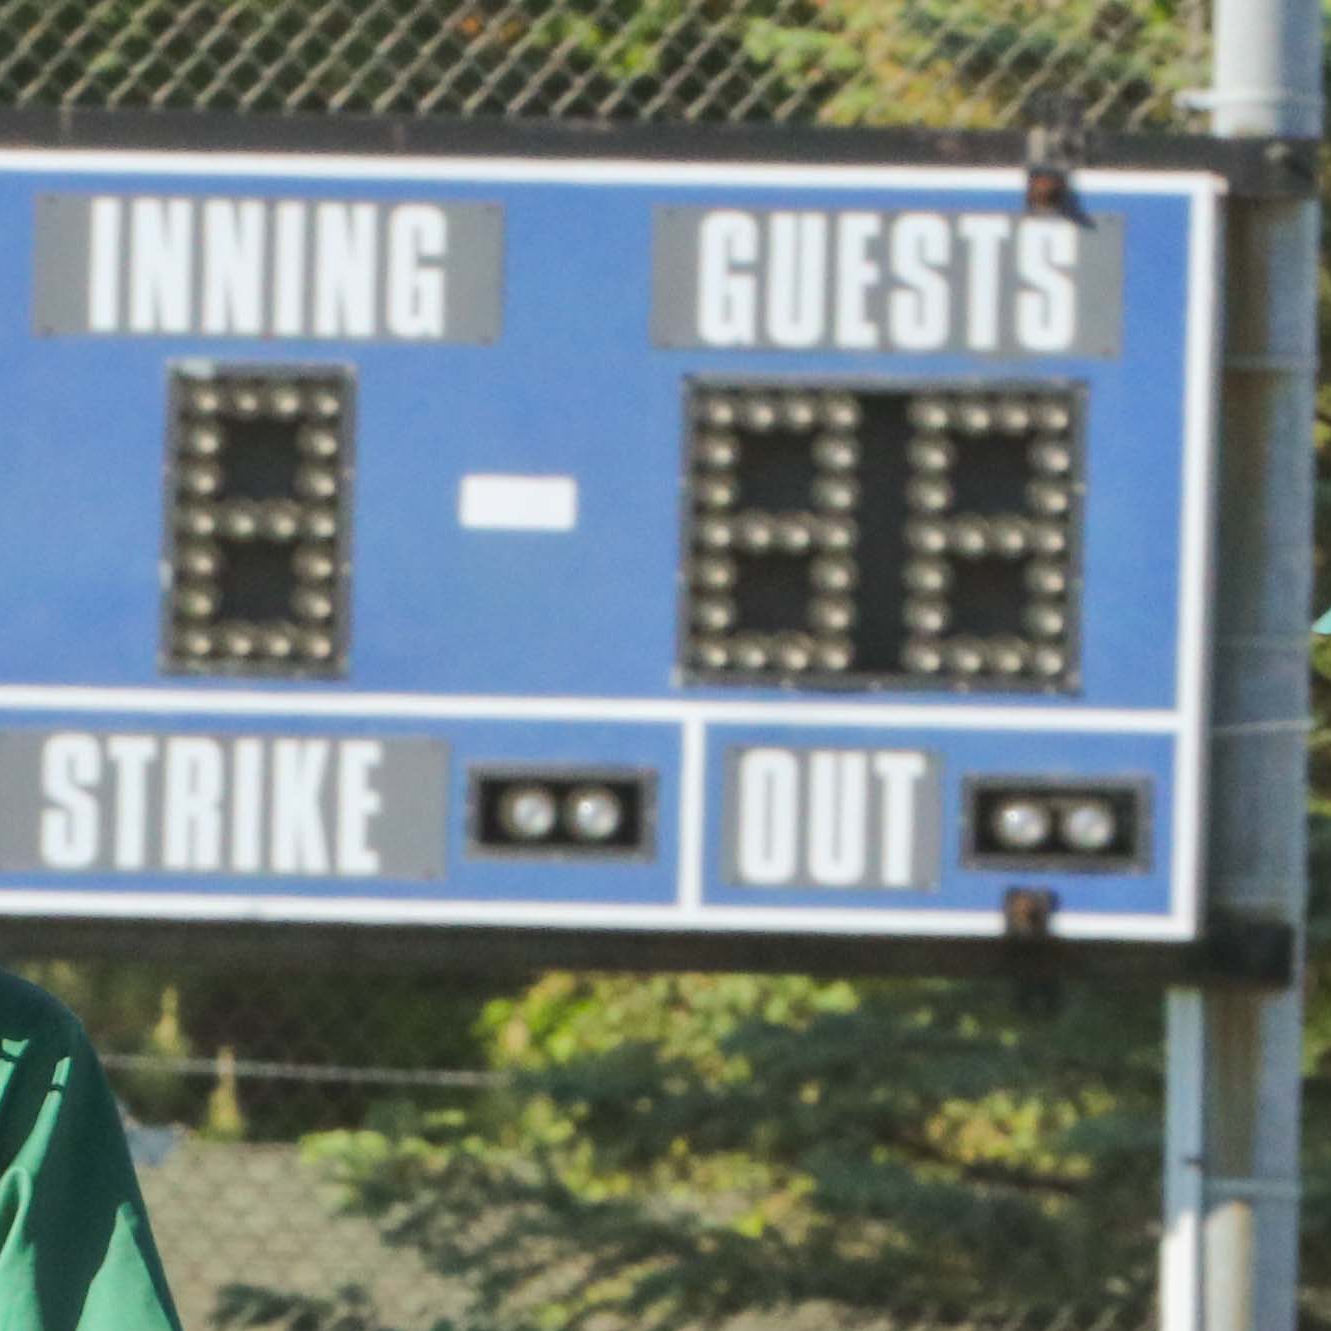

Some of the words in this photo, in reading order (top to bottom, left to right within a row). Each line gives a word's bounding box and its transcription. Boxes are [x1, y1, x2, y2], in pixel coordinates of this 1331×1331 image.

[87, 196, 448, 338] INNING
[696, 209, 1079, 352] GUESTS
[39, 734, 383, 876] STRIKE
[737, 746, 929, 890] OUT
